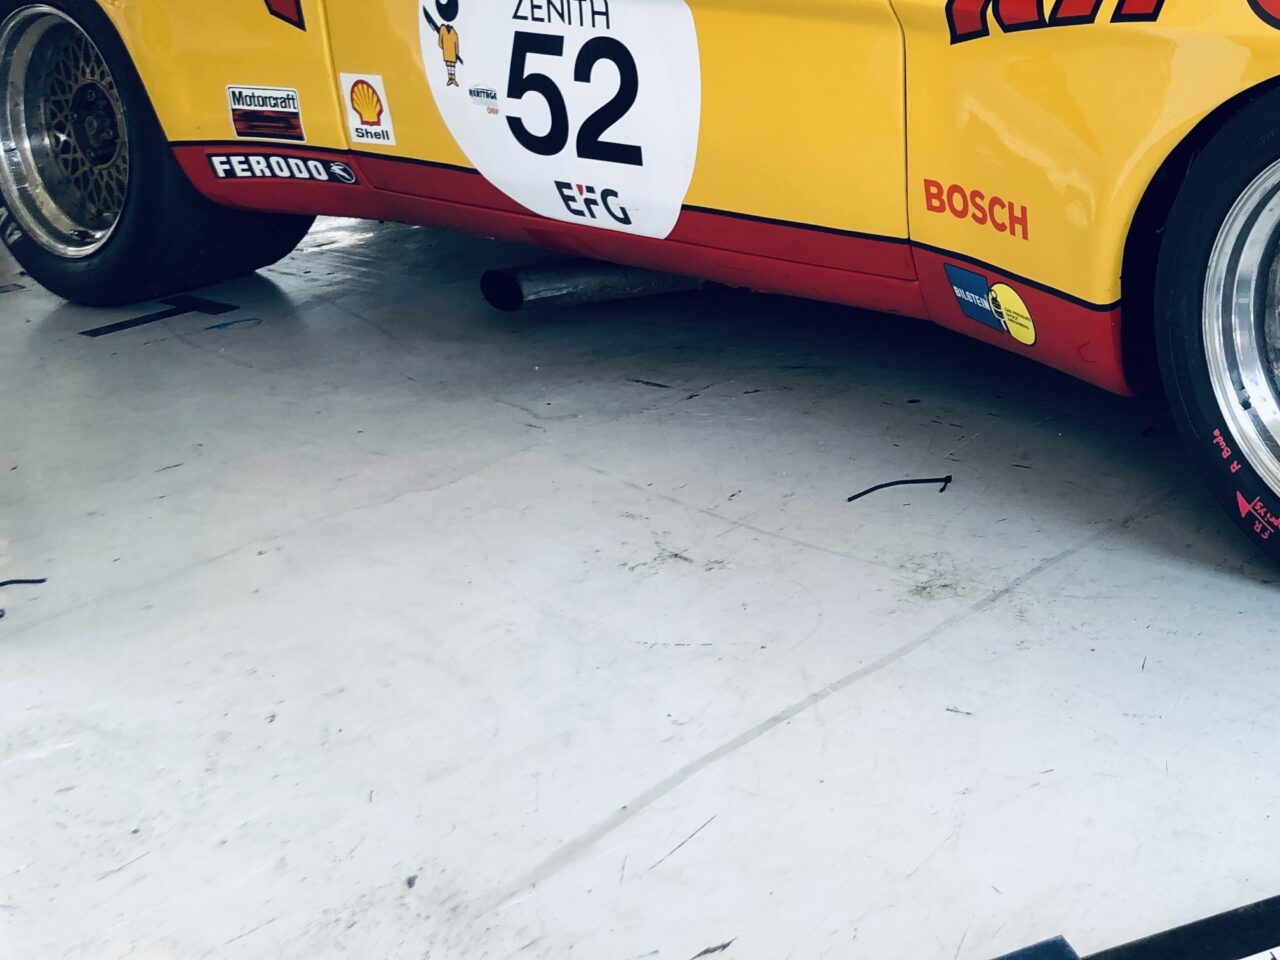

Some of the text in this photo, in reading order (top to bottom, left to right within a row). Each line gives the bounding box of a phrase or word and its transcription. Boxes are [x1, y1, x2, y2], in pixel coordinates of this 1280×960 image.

[231, 90, 297, 110] Motorcraft
[505, 30, 644, 167] 52
[355, 127, 391, 141] Shell
[211, 155, 330, 181] FERODO
[554, 179, 633, 225] EFG
[923, 178, 1029, 240] BOSCH
[952, 285, 991, 312] BILSTEIN
